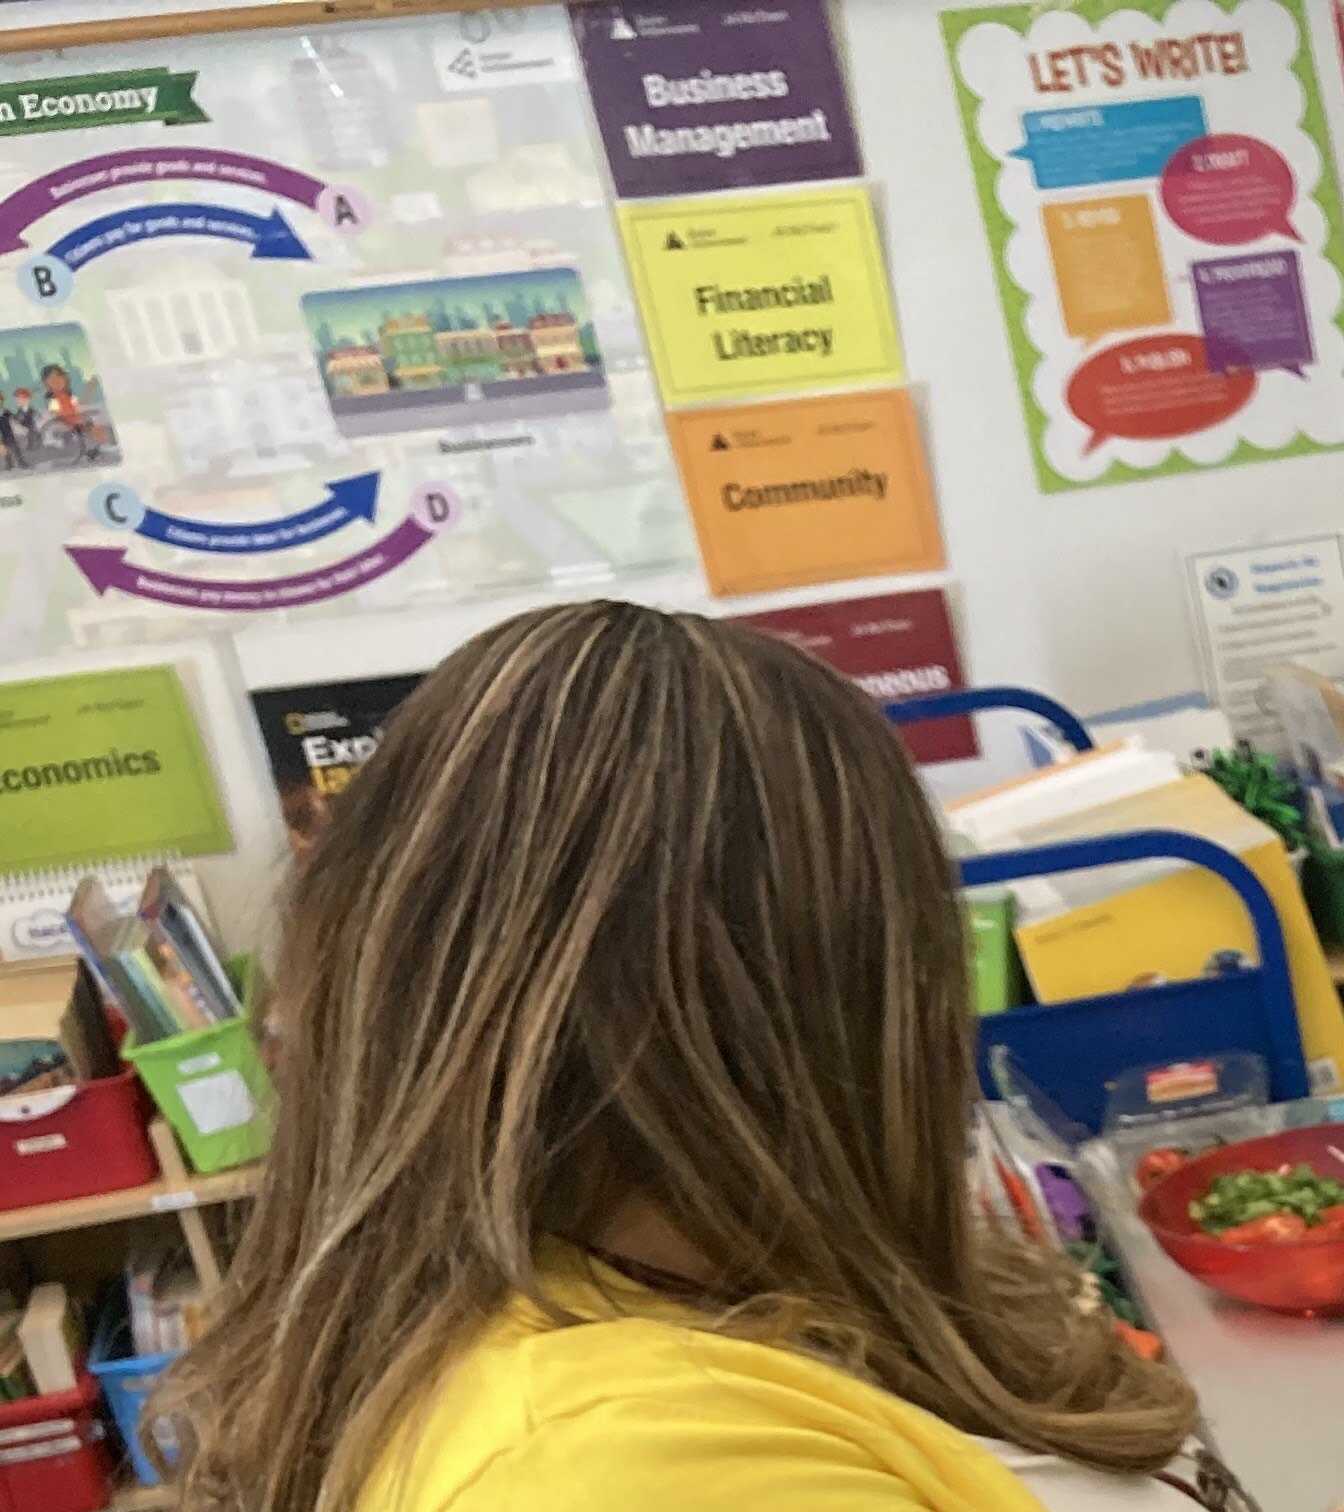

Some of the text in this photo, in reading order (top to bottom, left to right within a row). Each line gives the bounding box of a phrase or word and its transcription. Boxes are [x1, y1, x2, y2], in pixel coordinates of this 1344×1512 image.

[1027, 31, 1252, 94] LET'S WRITE!
[17, 86, 159, 122] Economy
[642, 69, 789, 108] Business
[623, 110, 831, 158] Management
[333, 193, 358, 226] A
[31, 265, 58, 299] B
[693, 274, 835, 317] Financial
[712, 325, 835, 362] Literacy
[106, 491, 128, 523] C
[425, 492, 450, 524] D
[720, 467, 889, 513] Community
[0, 745, 162, 794] conomics
